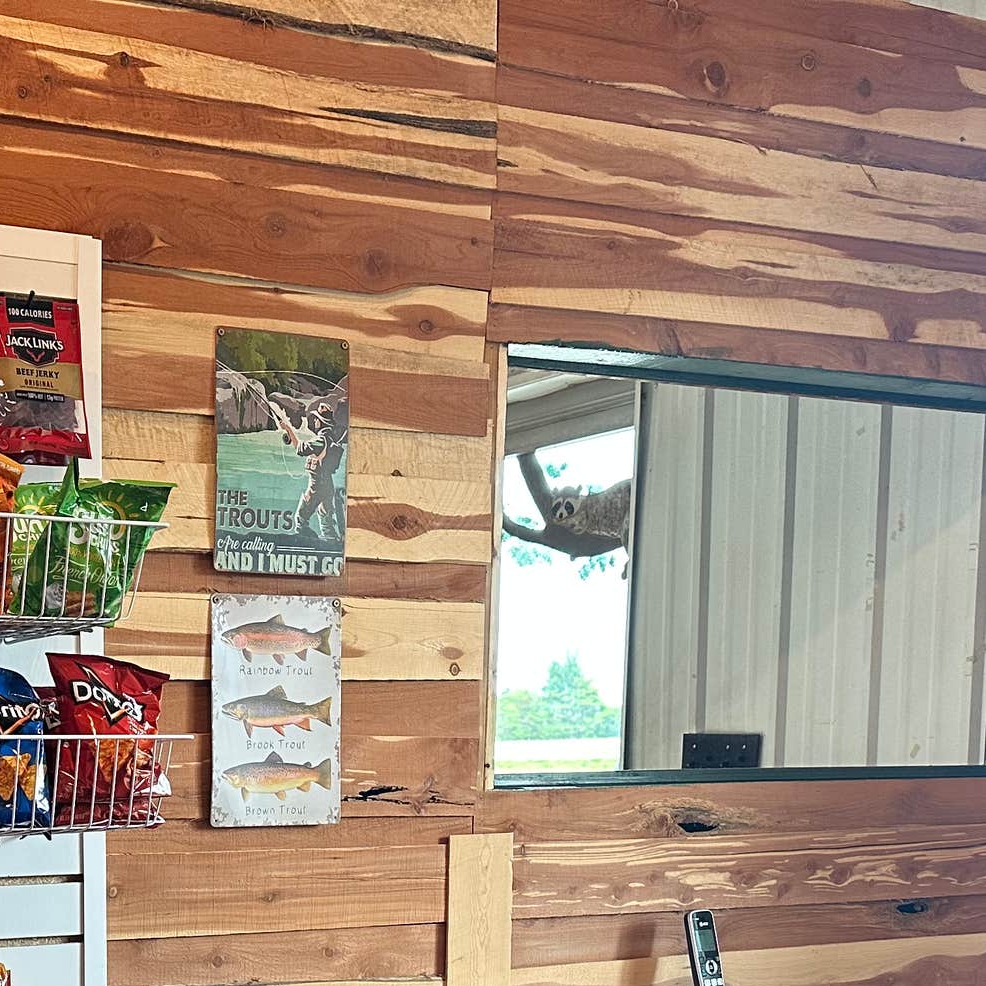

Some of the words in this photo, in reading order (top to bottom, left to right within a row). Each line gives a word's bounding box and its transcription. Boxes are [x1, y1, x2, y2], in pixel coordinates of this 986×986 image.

[7, 307, 20, 316] 100
[20, 307, 53, 319] CALORIES
[5, 334, 33, 348] JACK
[16, 367, 35, 377] BEEF
[35, 369, 59, 379] JERKY
[24, 378, 54, 389] ORIGINAL
[218, 490, 248, 506] THE
[217, 506, 295, 531] TROUTS
[241, 536, 275, 556] calling
[216, 551, 253, 571] AND
[258, 553, 265, 571] I
[269, 553, 318, 574] MUST
[321, 556, 344, 577] GO
[239, 664, 282, 676] Rainbow
[286, 665, 313, 676] Trout
[246, 739, 275, 750] Brook
[278, 739, 307, 750] Trout
[245, 806, 276, 816] Brown
[279, 805, 307, 816] Trout
